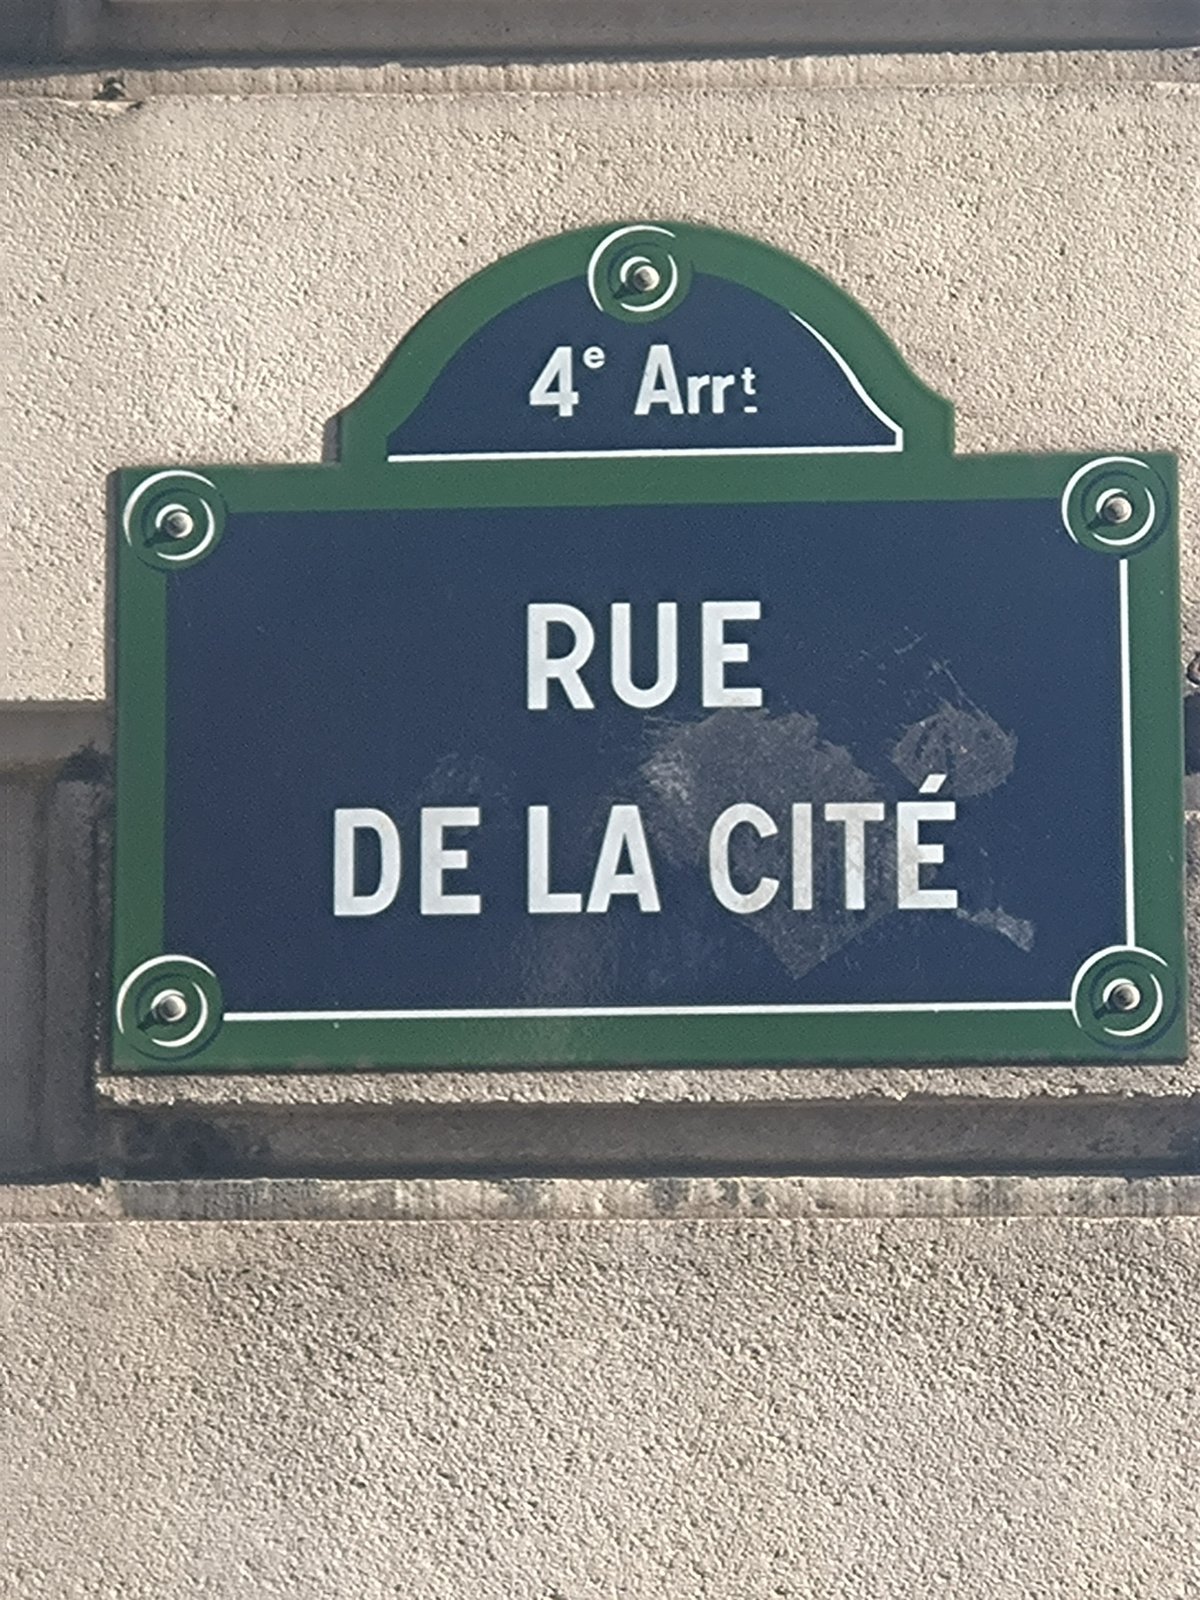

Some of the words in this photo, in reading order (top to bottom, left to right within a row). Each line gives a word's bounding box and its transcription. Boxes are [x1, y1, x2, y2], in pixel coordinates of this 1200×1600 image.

[527, 600, 763, 710] RUE
[333, 806, 481, 916] DE
[527, 804, 661, 914] LA
[709, 773, 958, 914] CITÉ
